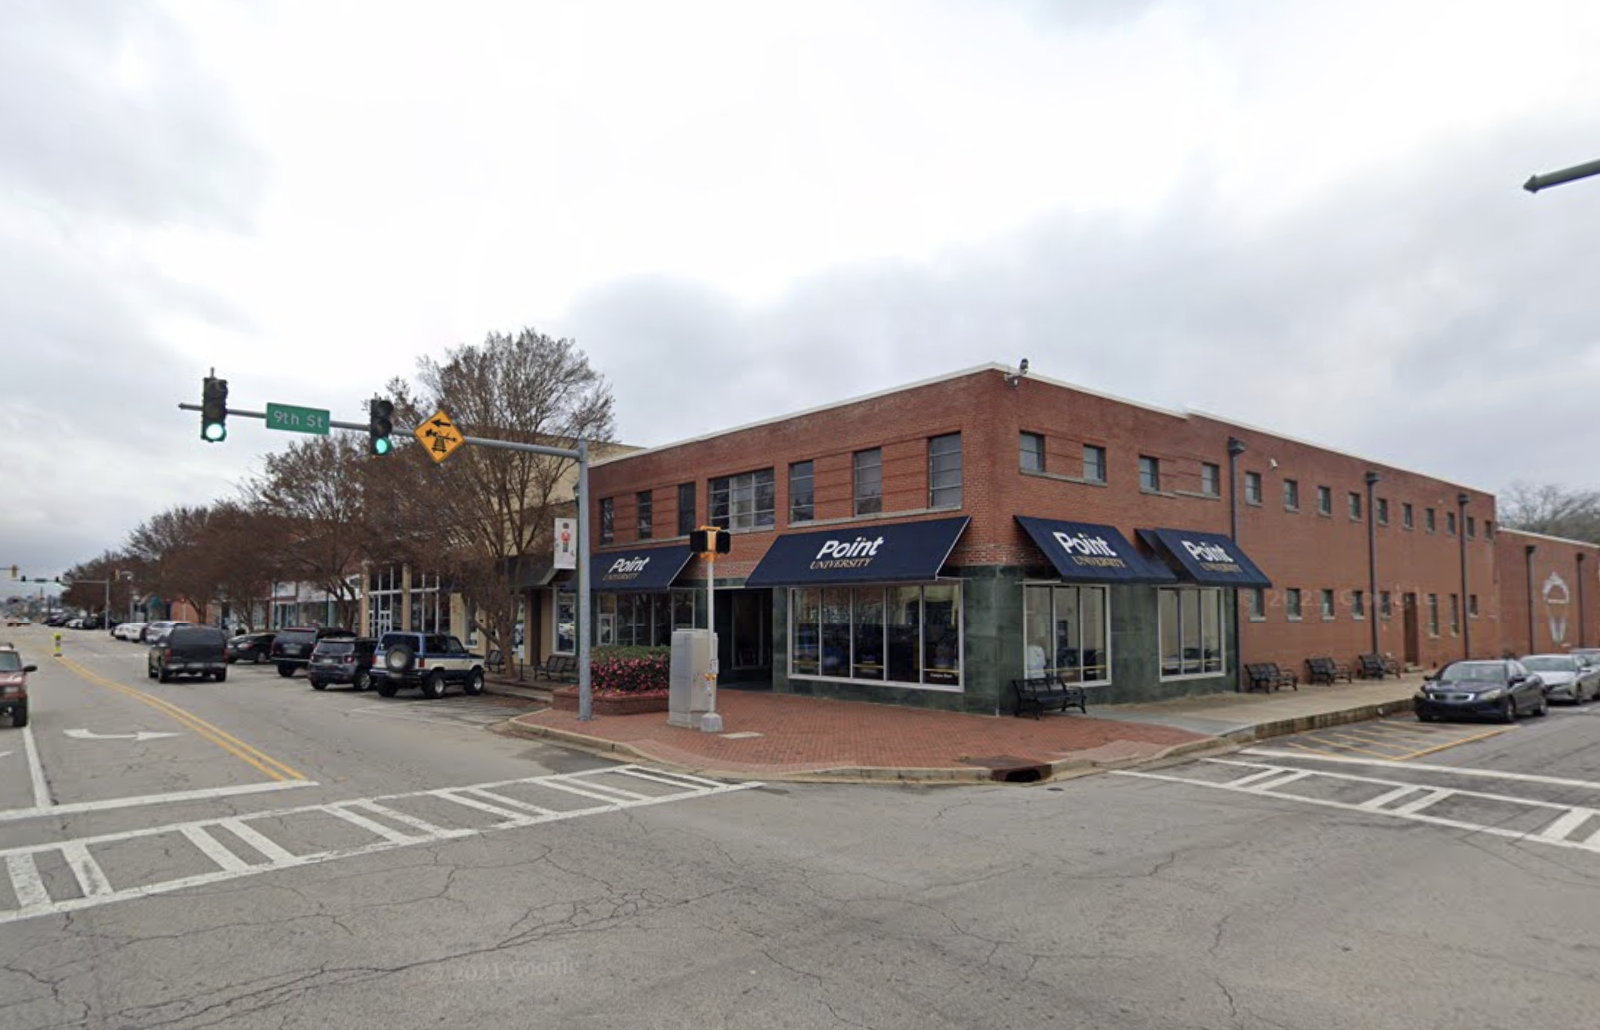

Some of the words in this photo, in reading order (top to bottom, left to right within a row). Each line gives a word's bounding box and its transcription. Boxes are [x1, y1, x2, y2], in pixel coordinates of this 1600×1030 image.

[273, 410, 300, 426] 9th
[306, 413, 324, 429] St
[815, 536, 885, 560] Point
[1052, 531, 1118, 557] Point
[1181, 540, 1234, 562] Point
[608, 556, 651, 574] Point
[809, 557, 874, 570] UNIVERSITY
